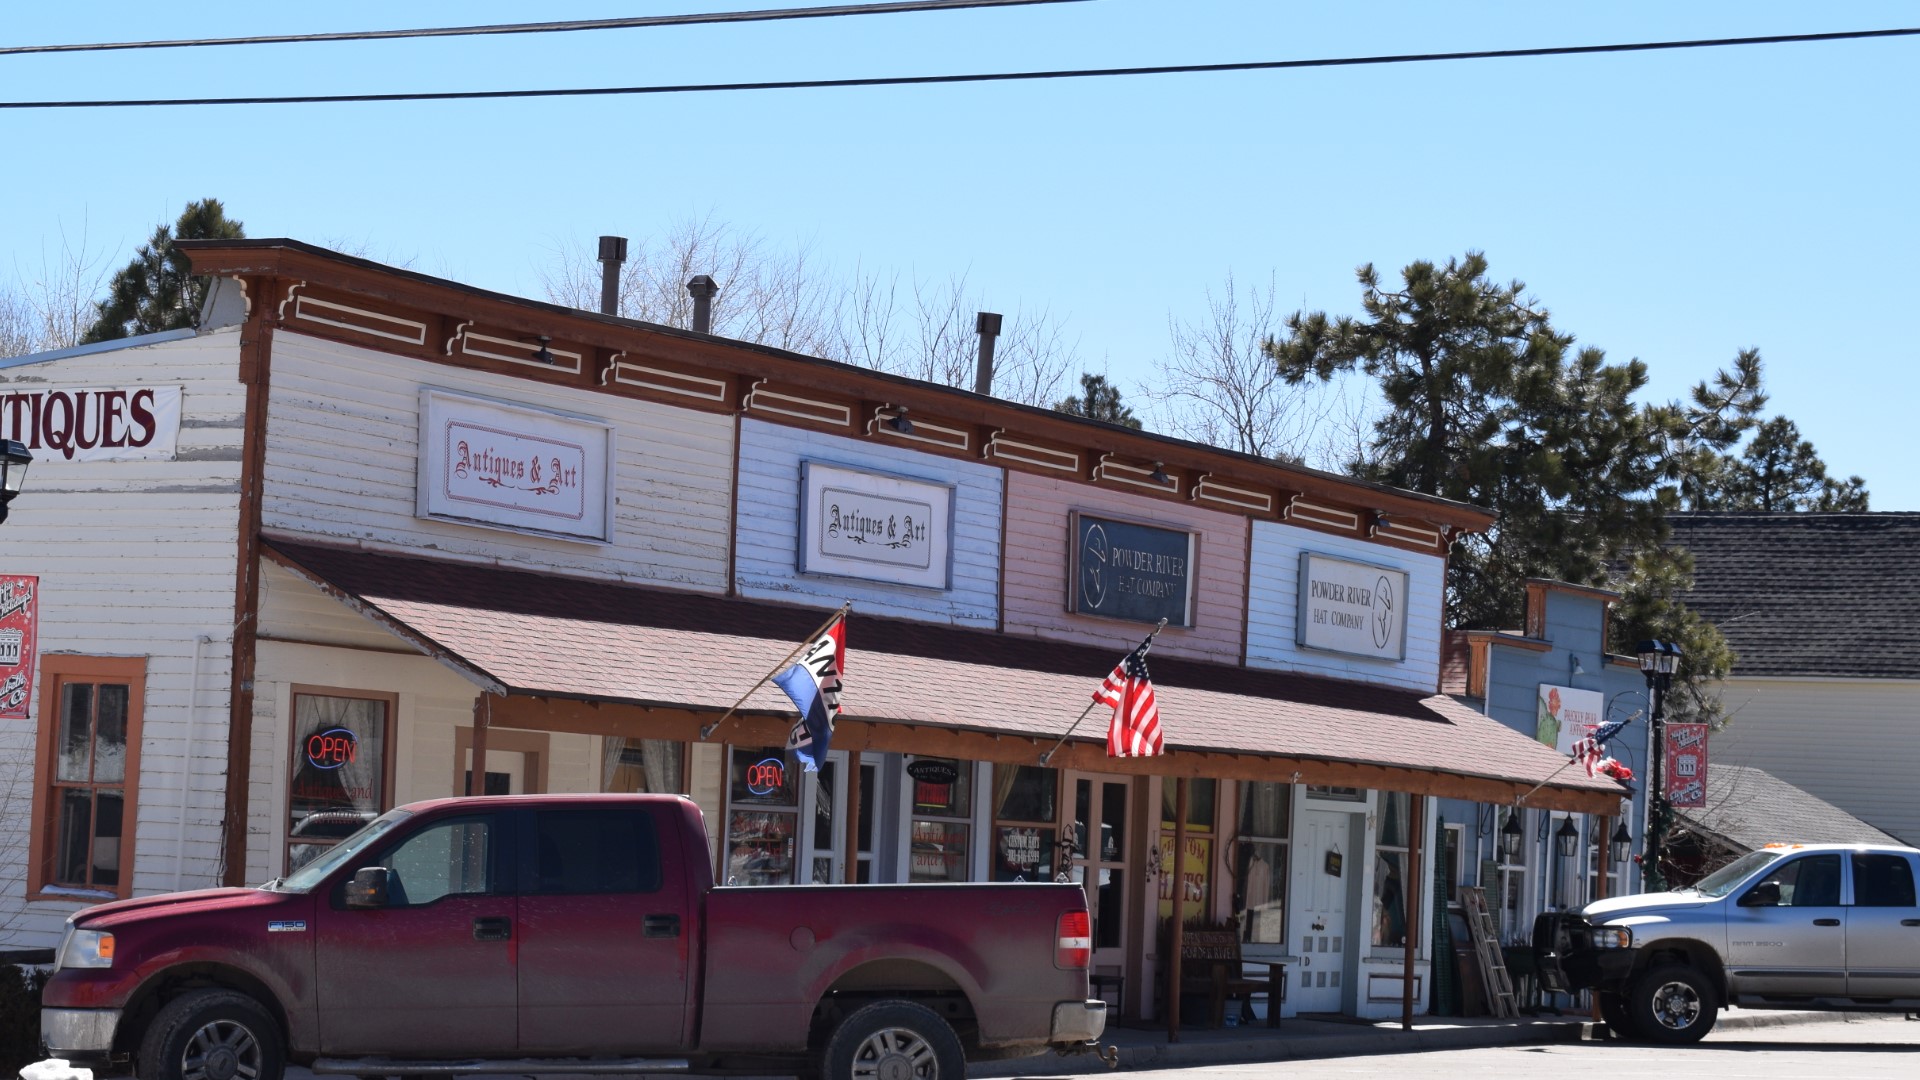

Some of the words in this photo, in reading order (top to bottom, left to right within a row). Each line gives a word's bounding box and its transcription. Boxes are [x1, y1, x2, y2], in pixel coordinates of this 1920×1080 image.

[0, 389, 156, 460] TIQUES
[455, 440, 525, 482] Antiques
[530, 455, 542, 484] &
[548, 457, 577, 495] Art
[828, 504, 884, 540] Antiques
[887, 514, 897, 539] &
[901, 515, 926, 548] Art
[1112, 547, 1154, 573] POWDER
[1156, 554, 1184, 577] RIVER
[1136, 578, 1177, 599] COMPANY
[1311, 579, 1345, 602] POWDER
[1346, 586, 1371, 607] RIVER
[1313, 608, 1328, 625] HAT
[1331, 610, 1365, 630] COMPANY
[308, 735, 357, 764] OPEN
[747, 765, 784, 788] OPEN
[914, 766, 952, 776] ANTIQUES
[351, 777, 374, 801] and
[916, 848, 938, 867] and
